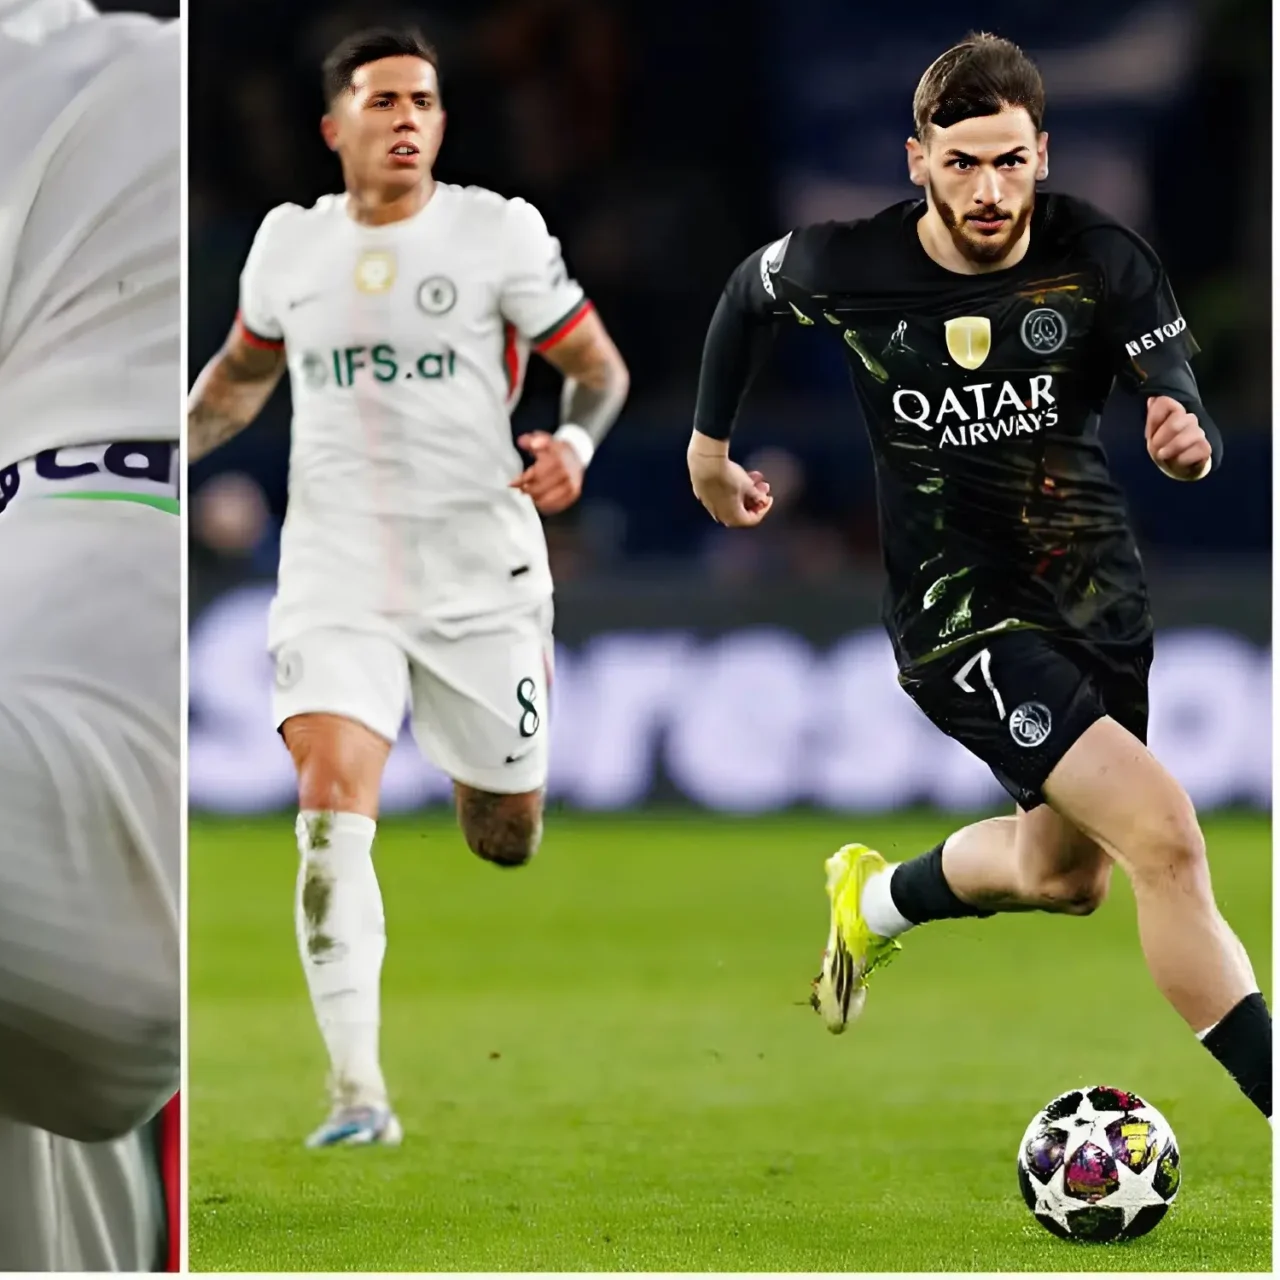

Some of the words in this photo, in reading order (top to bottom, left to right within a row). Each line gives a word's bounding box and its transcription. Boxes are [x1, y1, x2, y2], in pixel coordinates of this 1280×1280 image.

[892, 374, 1056, 431] QATAR
[938, 406, 1059, 449] AIRWAYS
[516, 676, 540, 738] 8
